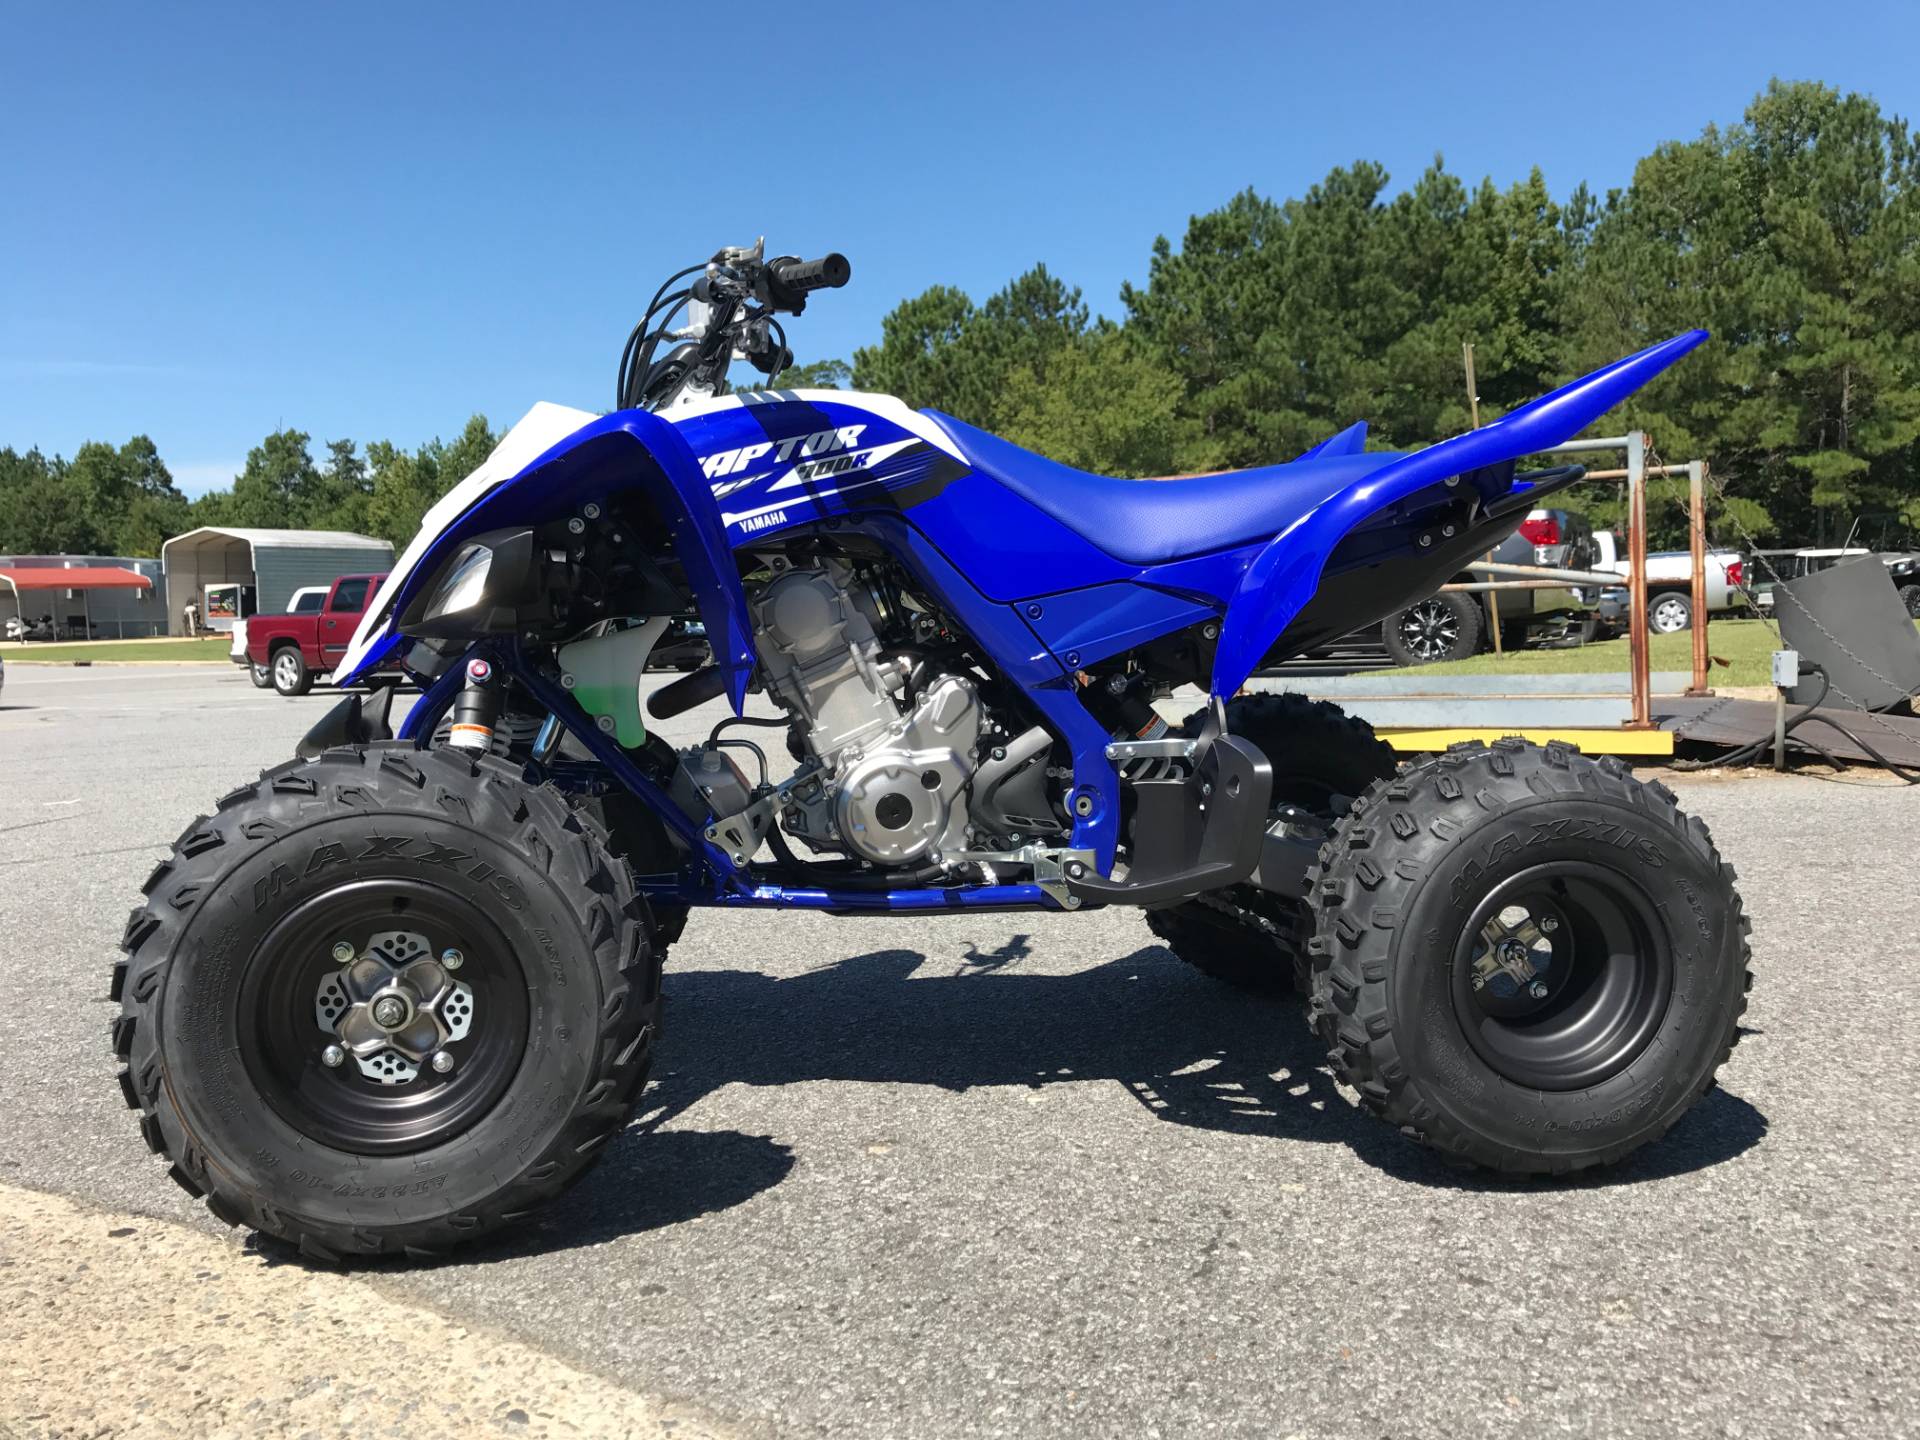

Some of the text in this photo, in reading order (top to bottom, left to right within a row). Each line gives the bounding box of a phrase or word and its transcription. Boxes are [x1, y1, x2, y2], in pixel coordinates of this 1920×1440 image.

[698, 424, 867, 479] APTOR
[797, 451, 872, 479] 700R
[739, 510, 787, 533] YAMAHA
[252, 834, 531, 914] MAXXIS
[1449, 817, 1667, 906] MAXXIS
